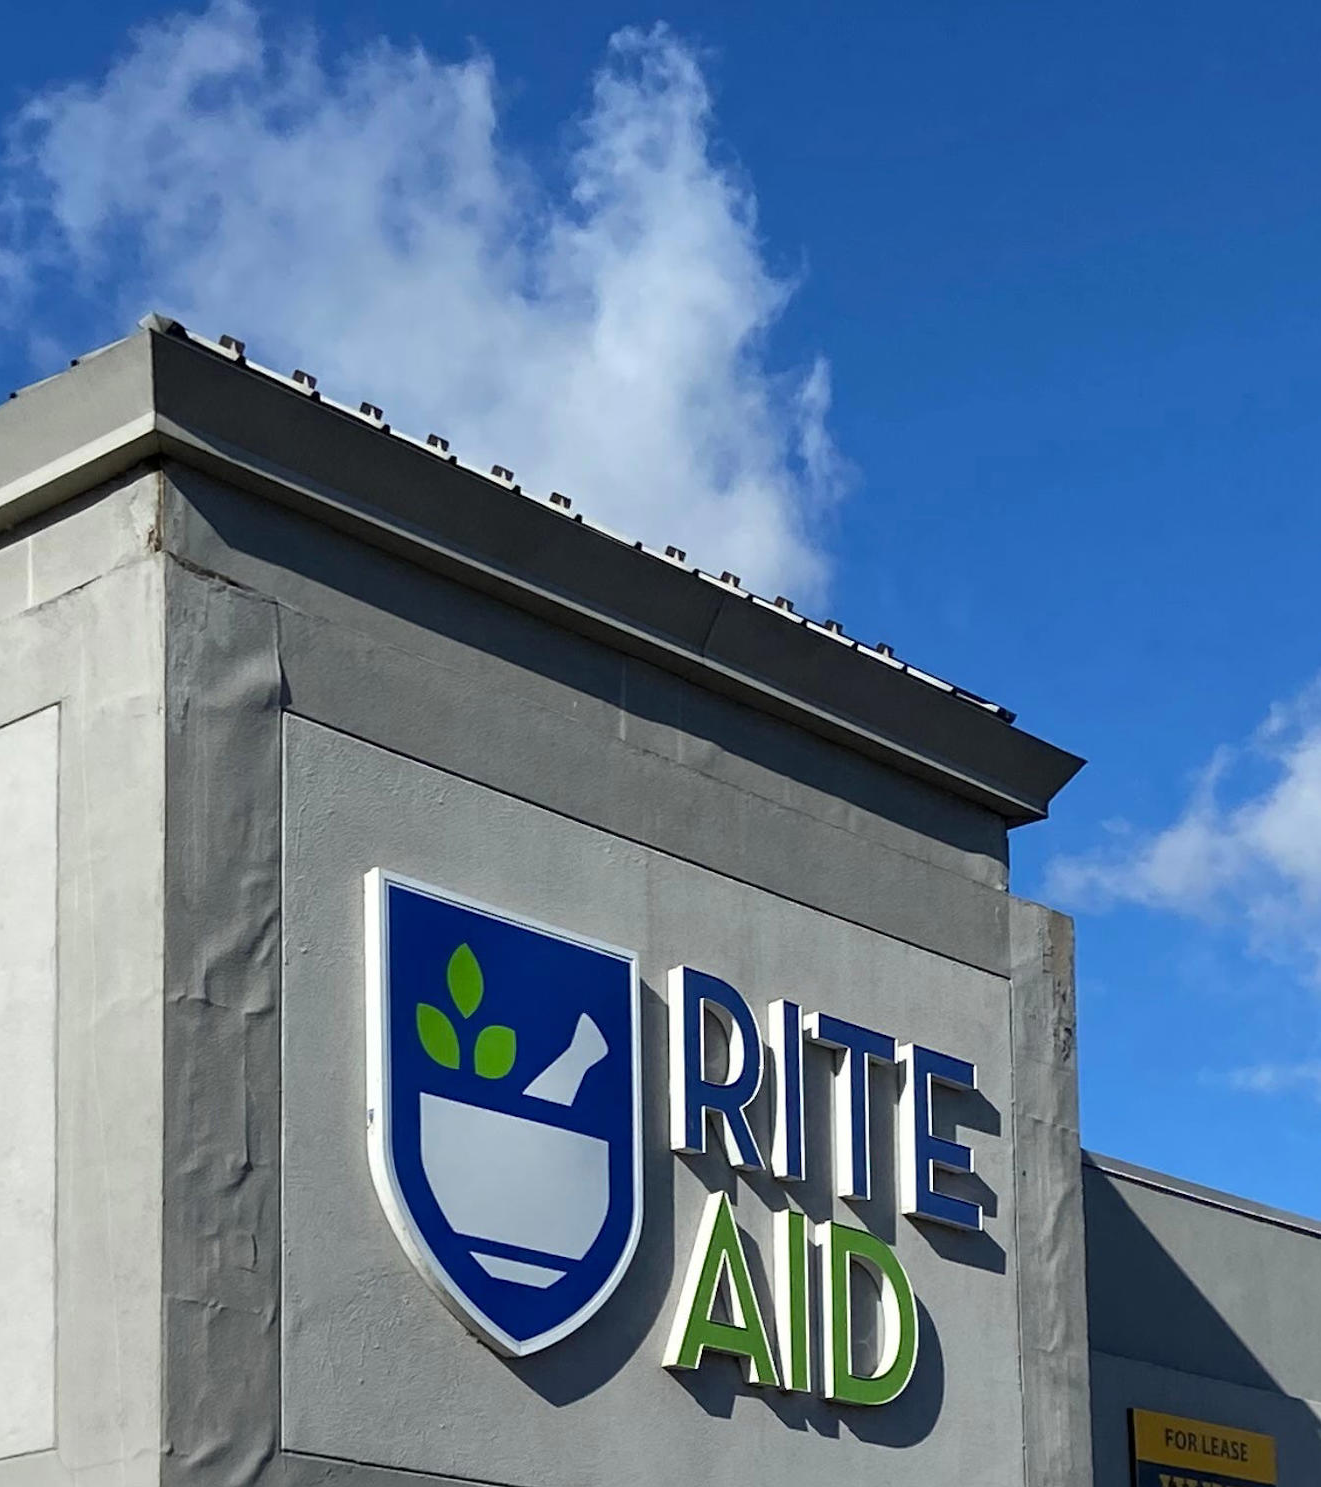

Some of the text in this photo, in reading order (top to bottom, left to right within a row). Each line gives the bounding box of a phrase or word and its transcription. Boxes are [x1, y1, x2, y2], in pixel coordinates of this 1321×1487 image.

[668, 964, 983, 1232] RITE
[662, 1191, 918, 1406] AID
[1164, 1428, 1249, 1462] FOR LEASE
